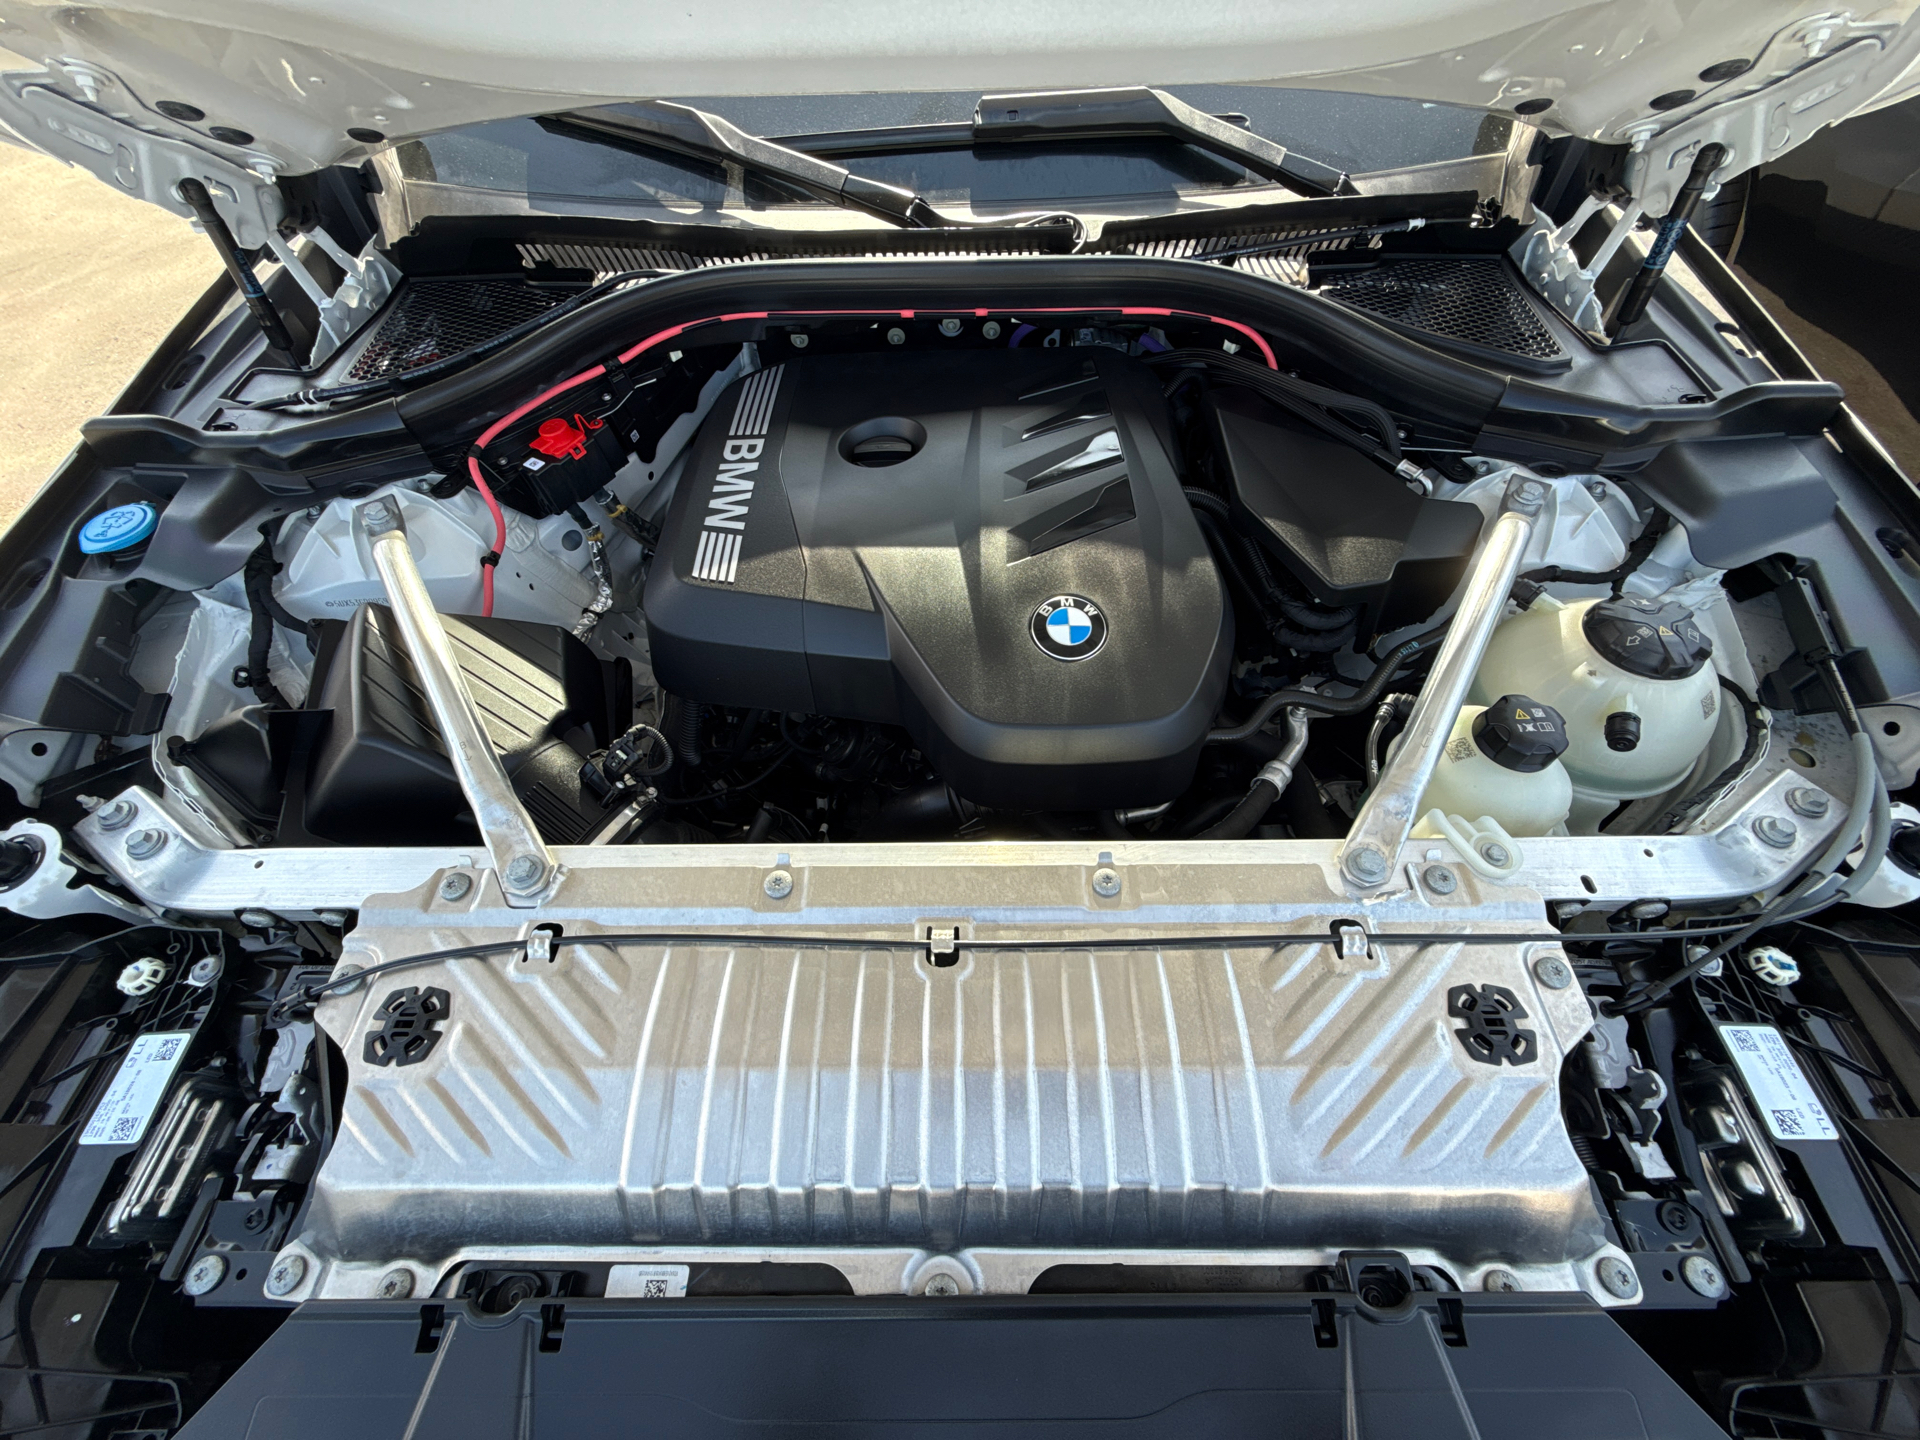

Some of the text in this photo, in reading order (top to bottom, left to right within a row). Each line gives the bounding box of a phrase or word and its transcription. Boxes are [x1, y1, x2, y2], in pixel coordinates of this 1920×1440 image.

[703, 438, 765, 530] BMW
[1039, 597, 1098, 617] BMW
[134, 1039, 148, 1055] LL
[1816, 1118, 1830, 1135] LL
